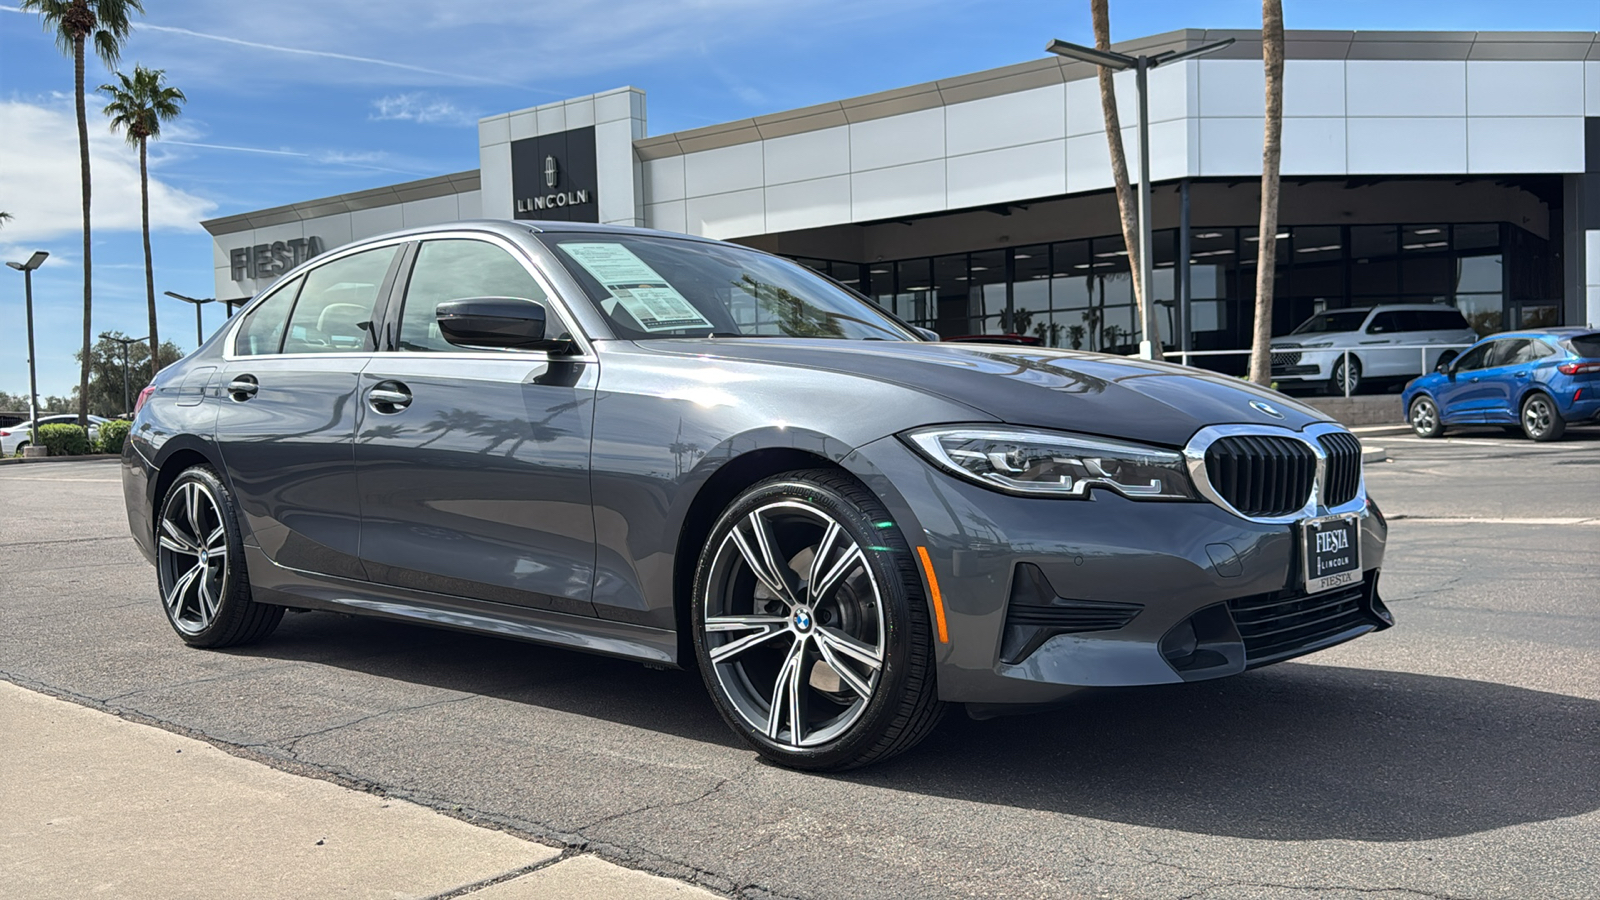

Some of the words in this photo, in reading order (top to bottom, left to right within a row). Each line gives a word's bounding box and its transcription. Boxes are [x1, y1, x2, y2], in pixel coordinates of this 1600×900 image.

[517, 189, 588, 213] LINCOLN
[230, 236, 324, 281] FIESTA
[1316, 530, 1349, 553] FIESTA
[1321, 557, 1349, 570] LINCOLN
[1321, 573, 1352, 588] FIESTA
